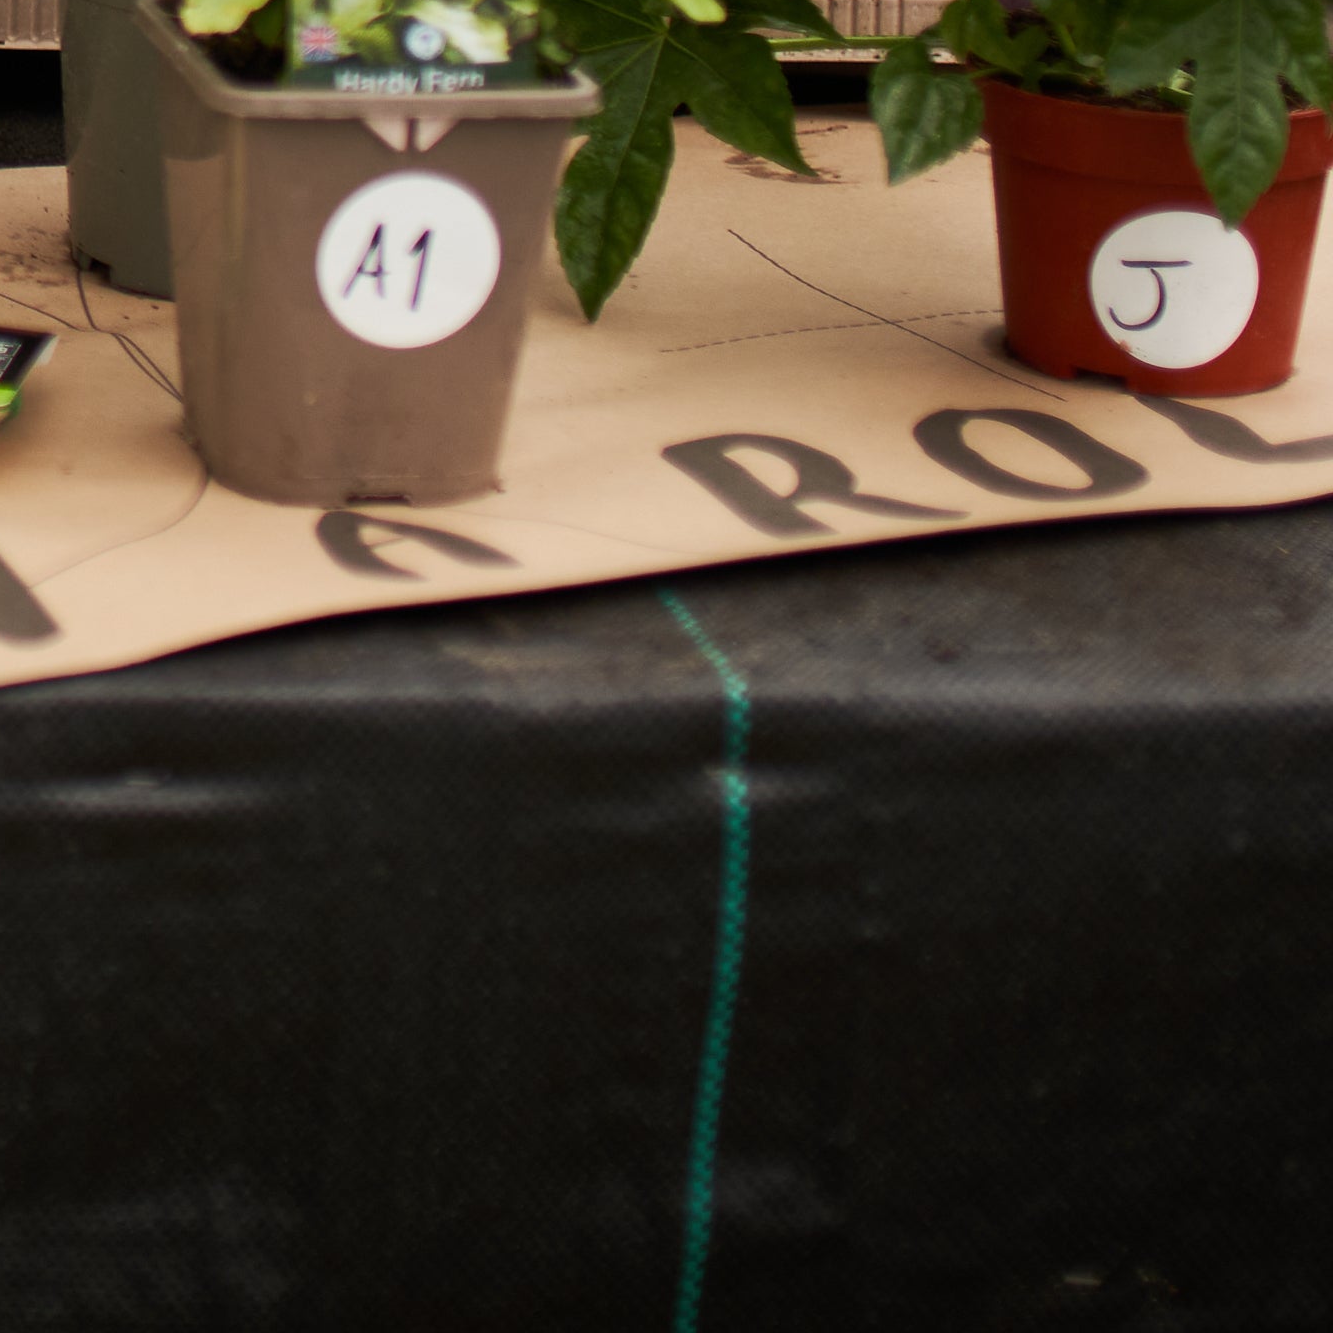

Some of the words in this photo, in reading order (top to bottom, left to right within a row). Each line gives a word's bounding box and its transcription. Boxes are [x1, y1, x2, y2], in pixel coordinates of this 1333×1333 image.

[337, 67, 420, 96] Hardy
[427, 67, 486, 93] Fern
[339, 223, 434, 313] A1
[1107, 258, 1194, 332] J
